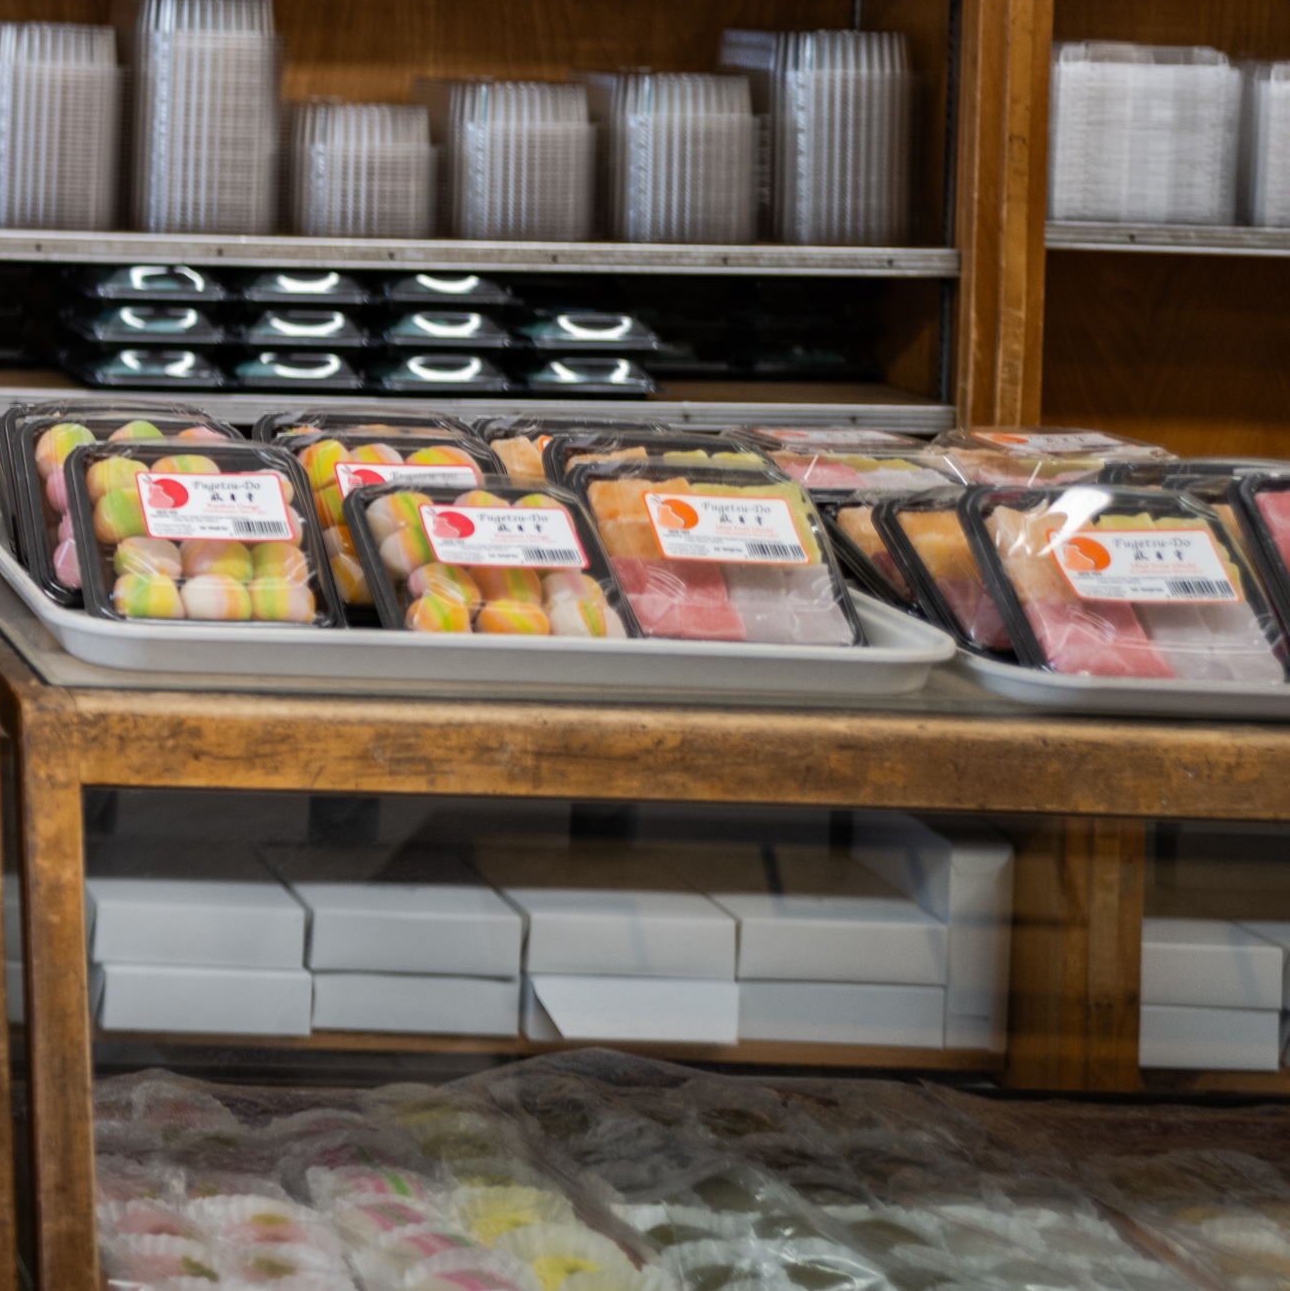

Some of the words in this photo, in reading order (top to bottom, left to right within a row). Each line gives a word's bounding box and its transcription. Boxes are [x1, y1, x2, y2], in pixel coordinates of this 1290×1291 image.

[192, 480, 261, 492] Fugetsu-Do
[701, 501, 771, 514] Fugetsu-Do
[477, 512, 549, 523] Fugetsu-Do
[1112, 537, 1191, 550] Fugetsu-Do
